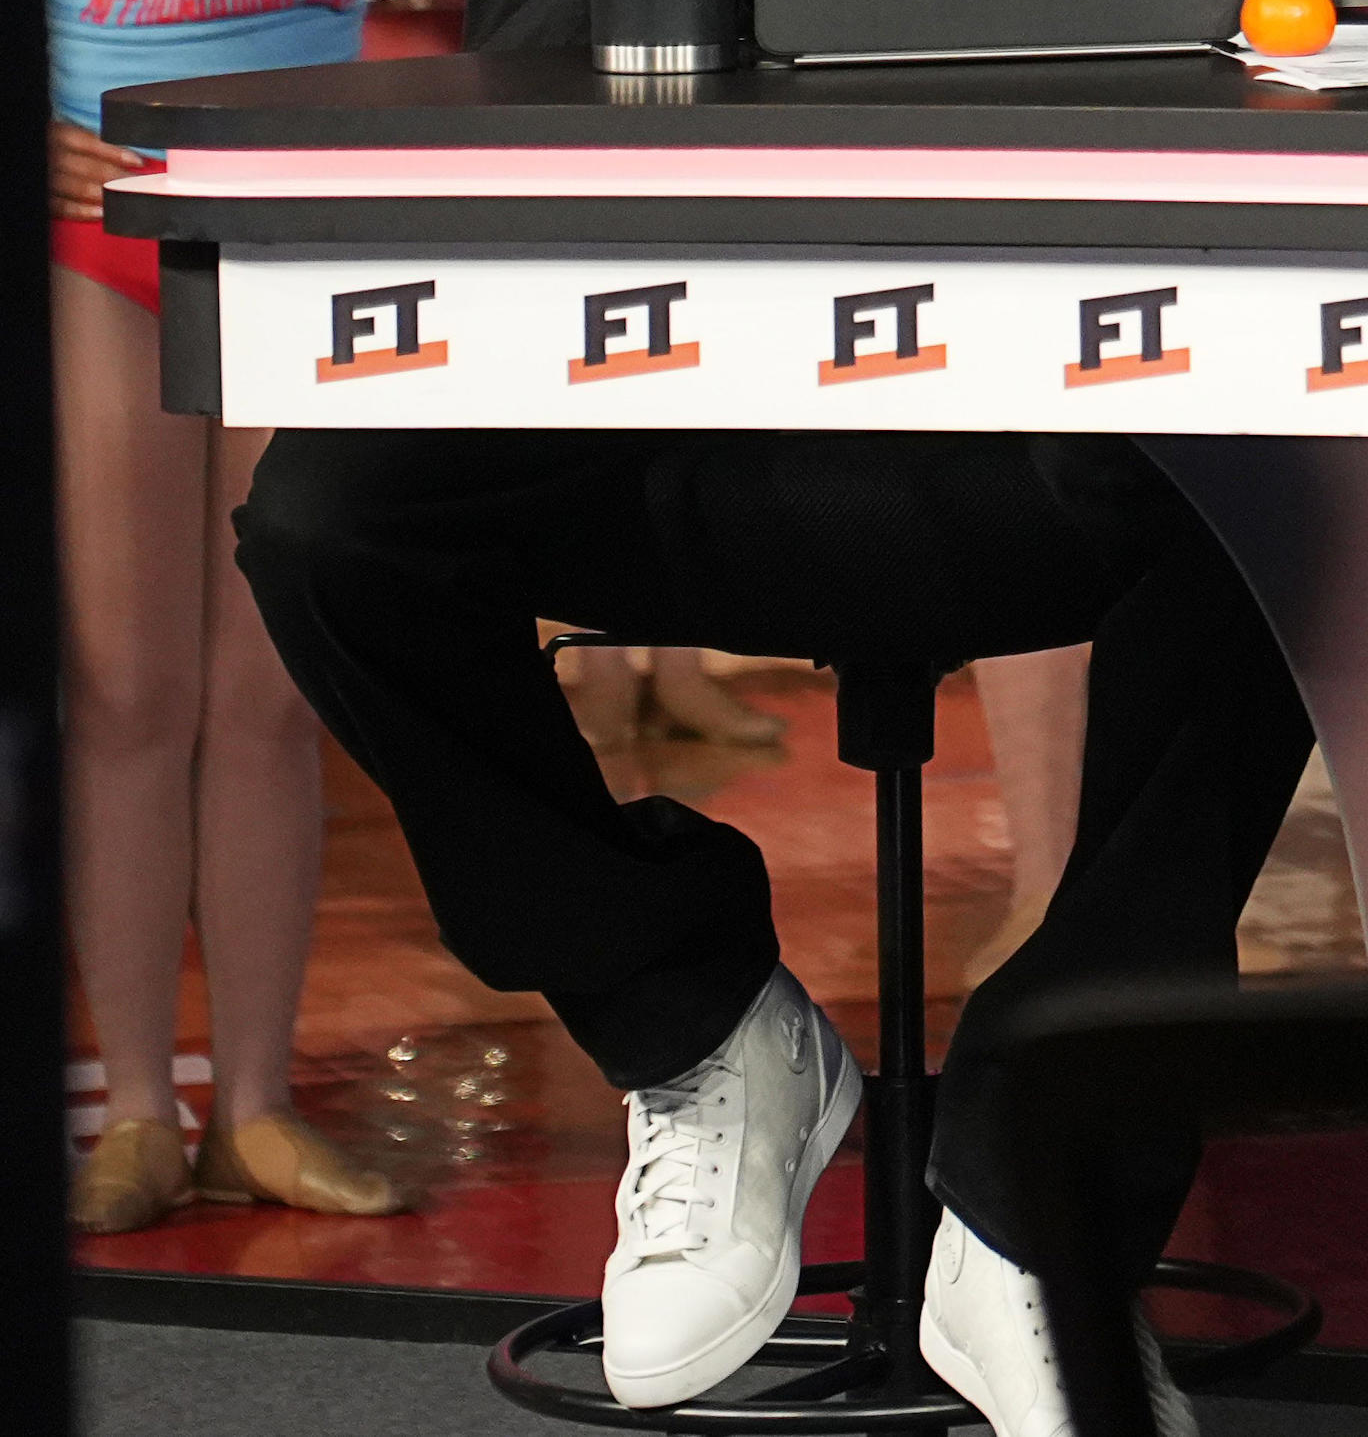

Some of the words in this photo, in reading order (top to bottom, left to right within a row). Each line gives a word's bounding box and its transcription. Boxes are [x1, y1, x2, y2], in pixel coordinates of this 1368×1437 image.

[332, 280, 435, 364] FT
[585, 282, 686, 365] FT
[834, 283, 933, 367] FT
[1079, 287, 1176, 370] FT
